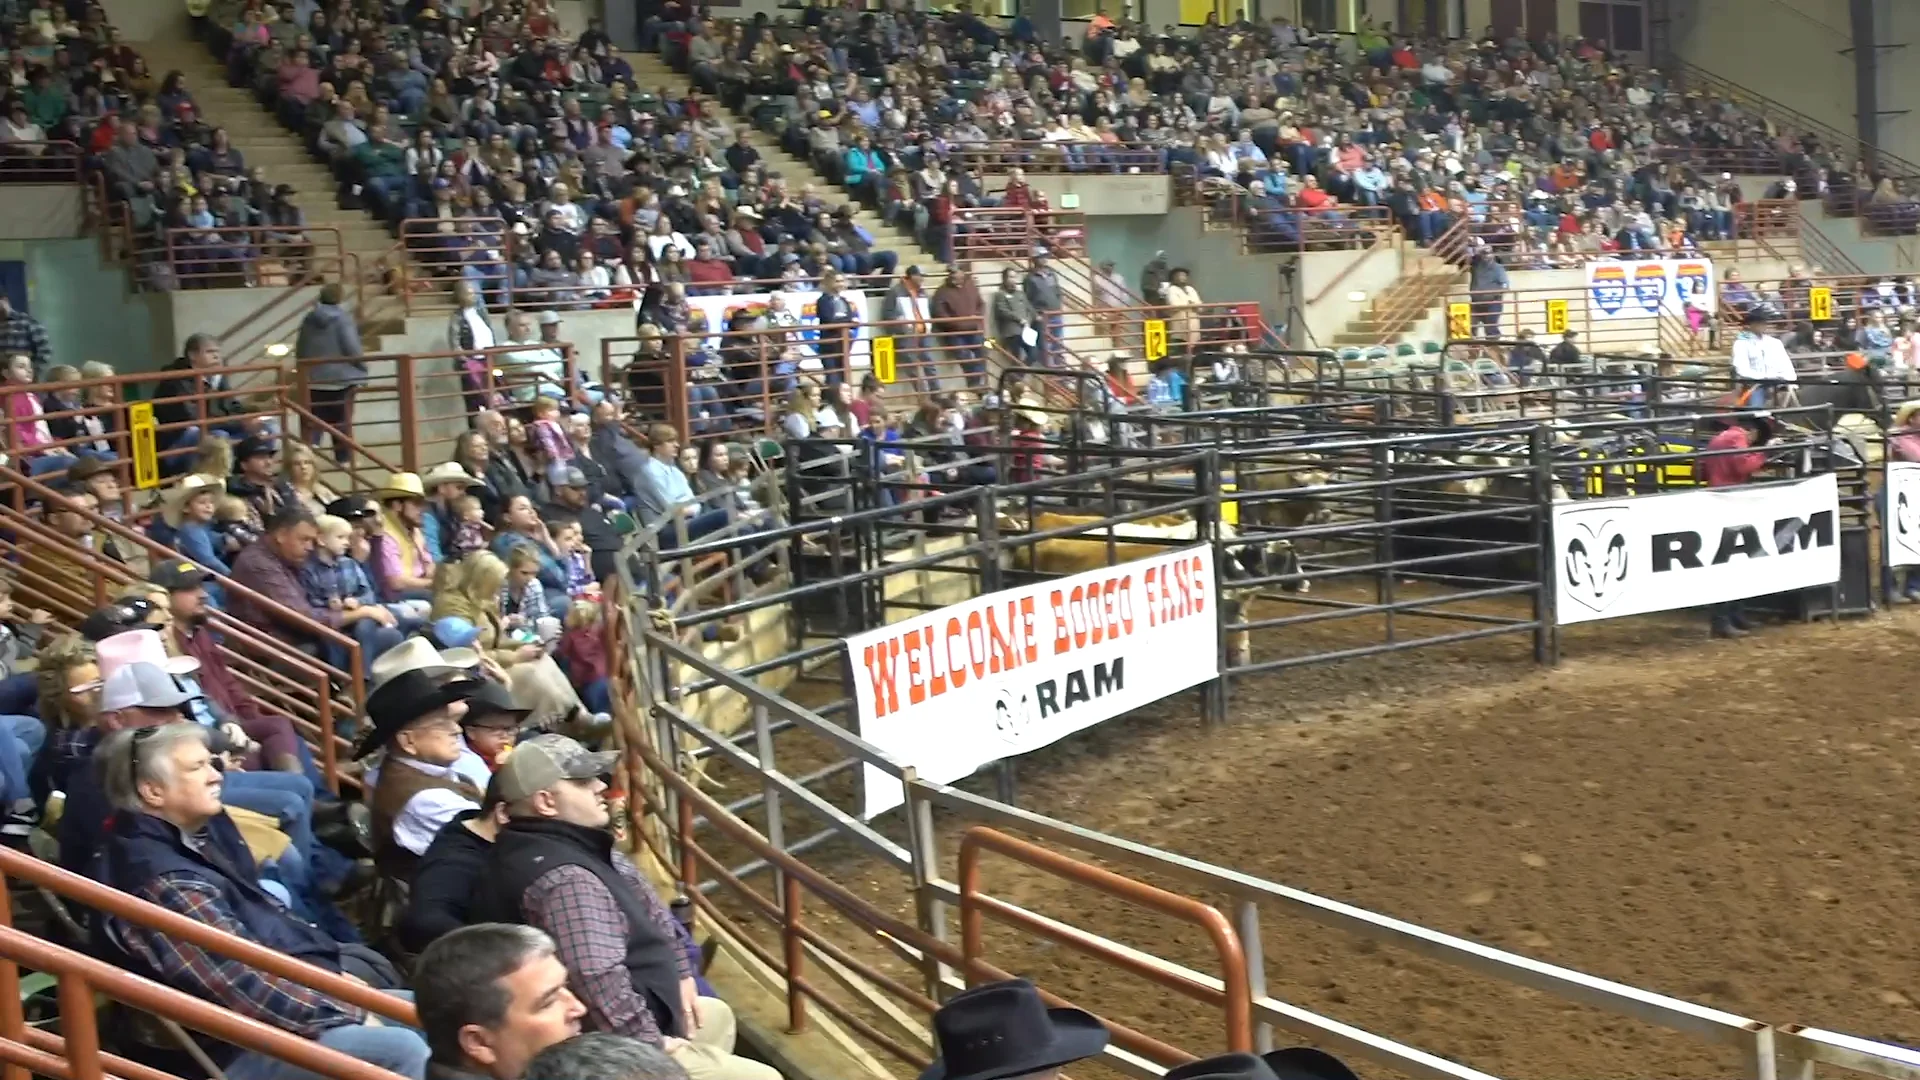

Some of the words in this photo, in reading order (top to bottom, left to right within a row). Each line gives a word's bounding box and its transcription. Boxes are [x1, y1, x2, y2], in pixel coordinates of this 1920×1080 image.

[1651, 509, 1834, 573] RAM
[864, 595, 1038, 719] WELCOME
[1050, 574, 1134, 656] RODEO
[1143, 555, 1205, 628] FANS
[1035, 656, 1125, 720] RAM
